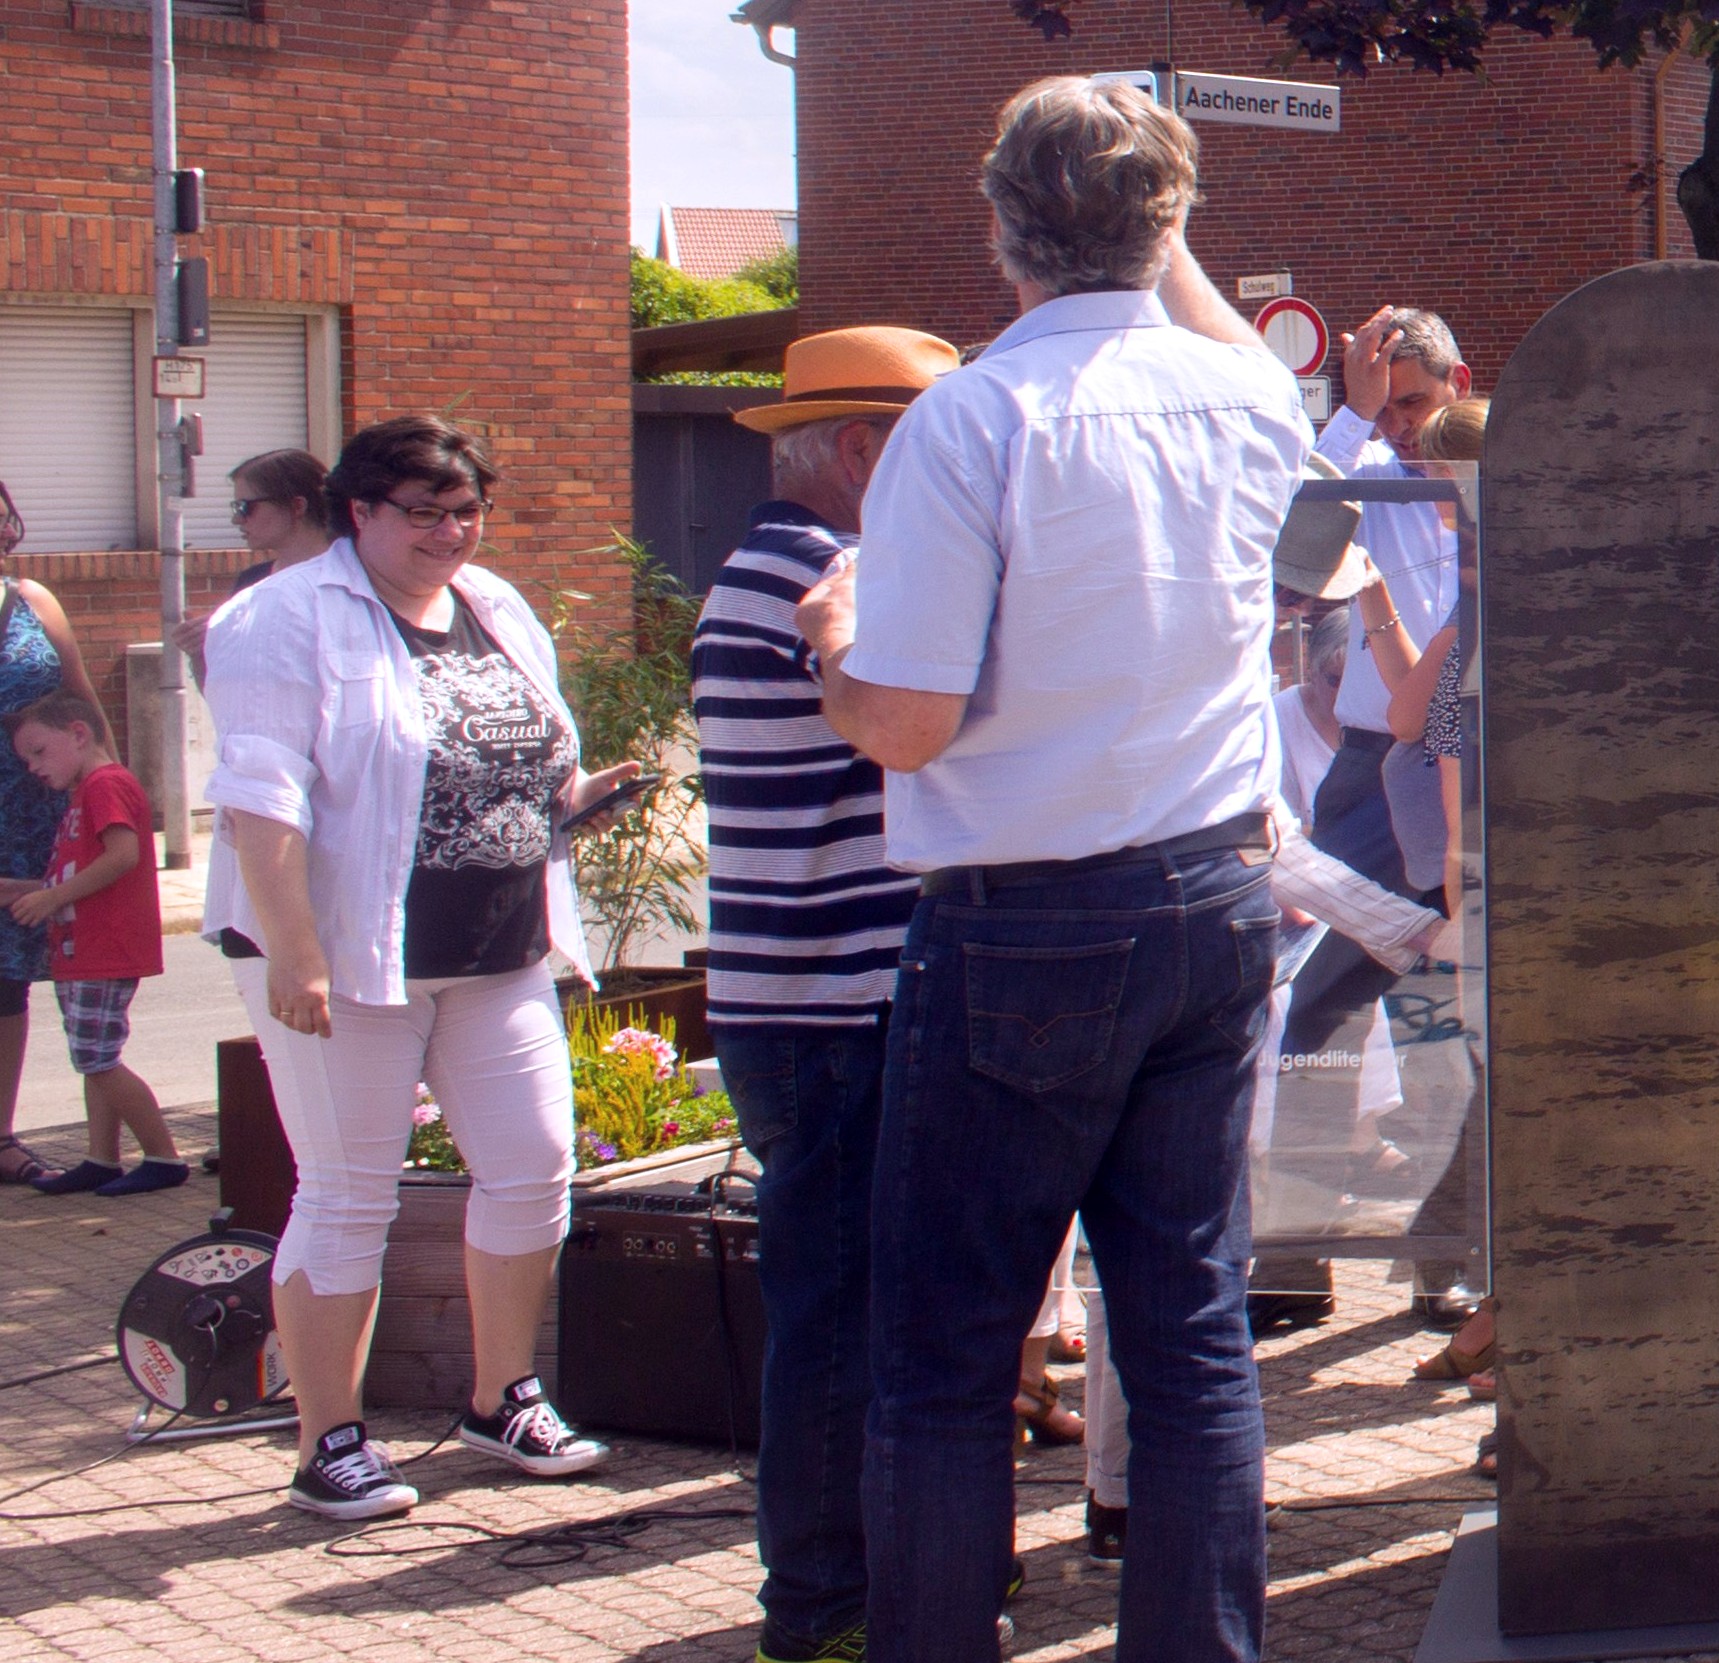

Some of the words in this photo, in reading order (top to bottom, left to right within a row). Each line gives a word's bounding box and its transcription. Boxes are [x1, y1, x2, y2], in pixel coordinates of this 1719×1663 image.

[1185, 86, 1280, 115] Aachener
[1286, 96, 1334, 119] Ende
[463, 713, 552, 742] Casual
[268, 1351, 277, 1387] WORK
